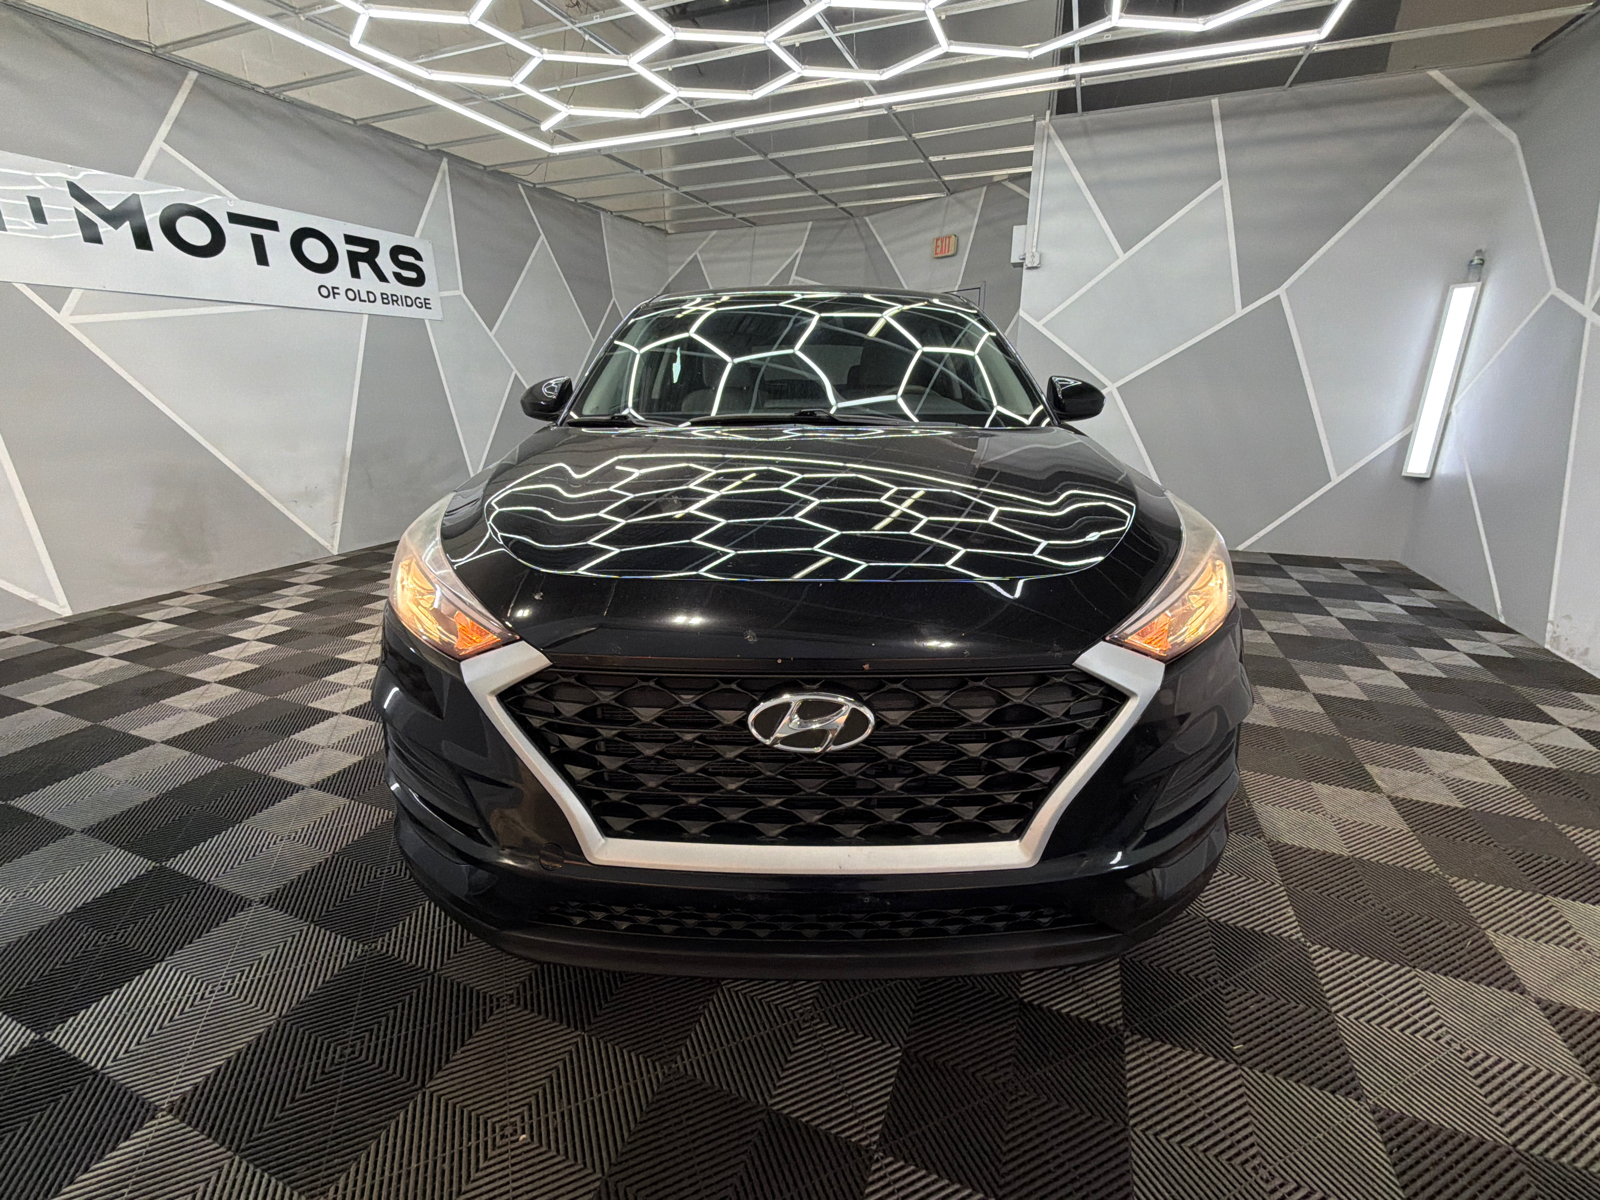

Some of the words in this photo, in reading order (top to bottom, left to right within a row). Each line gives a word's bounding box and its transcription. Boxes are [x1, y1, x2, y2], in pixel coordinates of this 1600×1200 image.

[66, 180, 427, 288] MOTORS
[934, 235, 953, 256] EXIT
[317, 284, 341, 300] OF
[344, 287, 377, 304] OLD
[380, 292, 433, 310] BRIDGE
